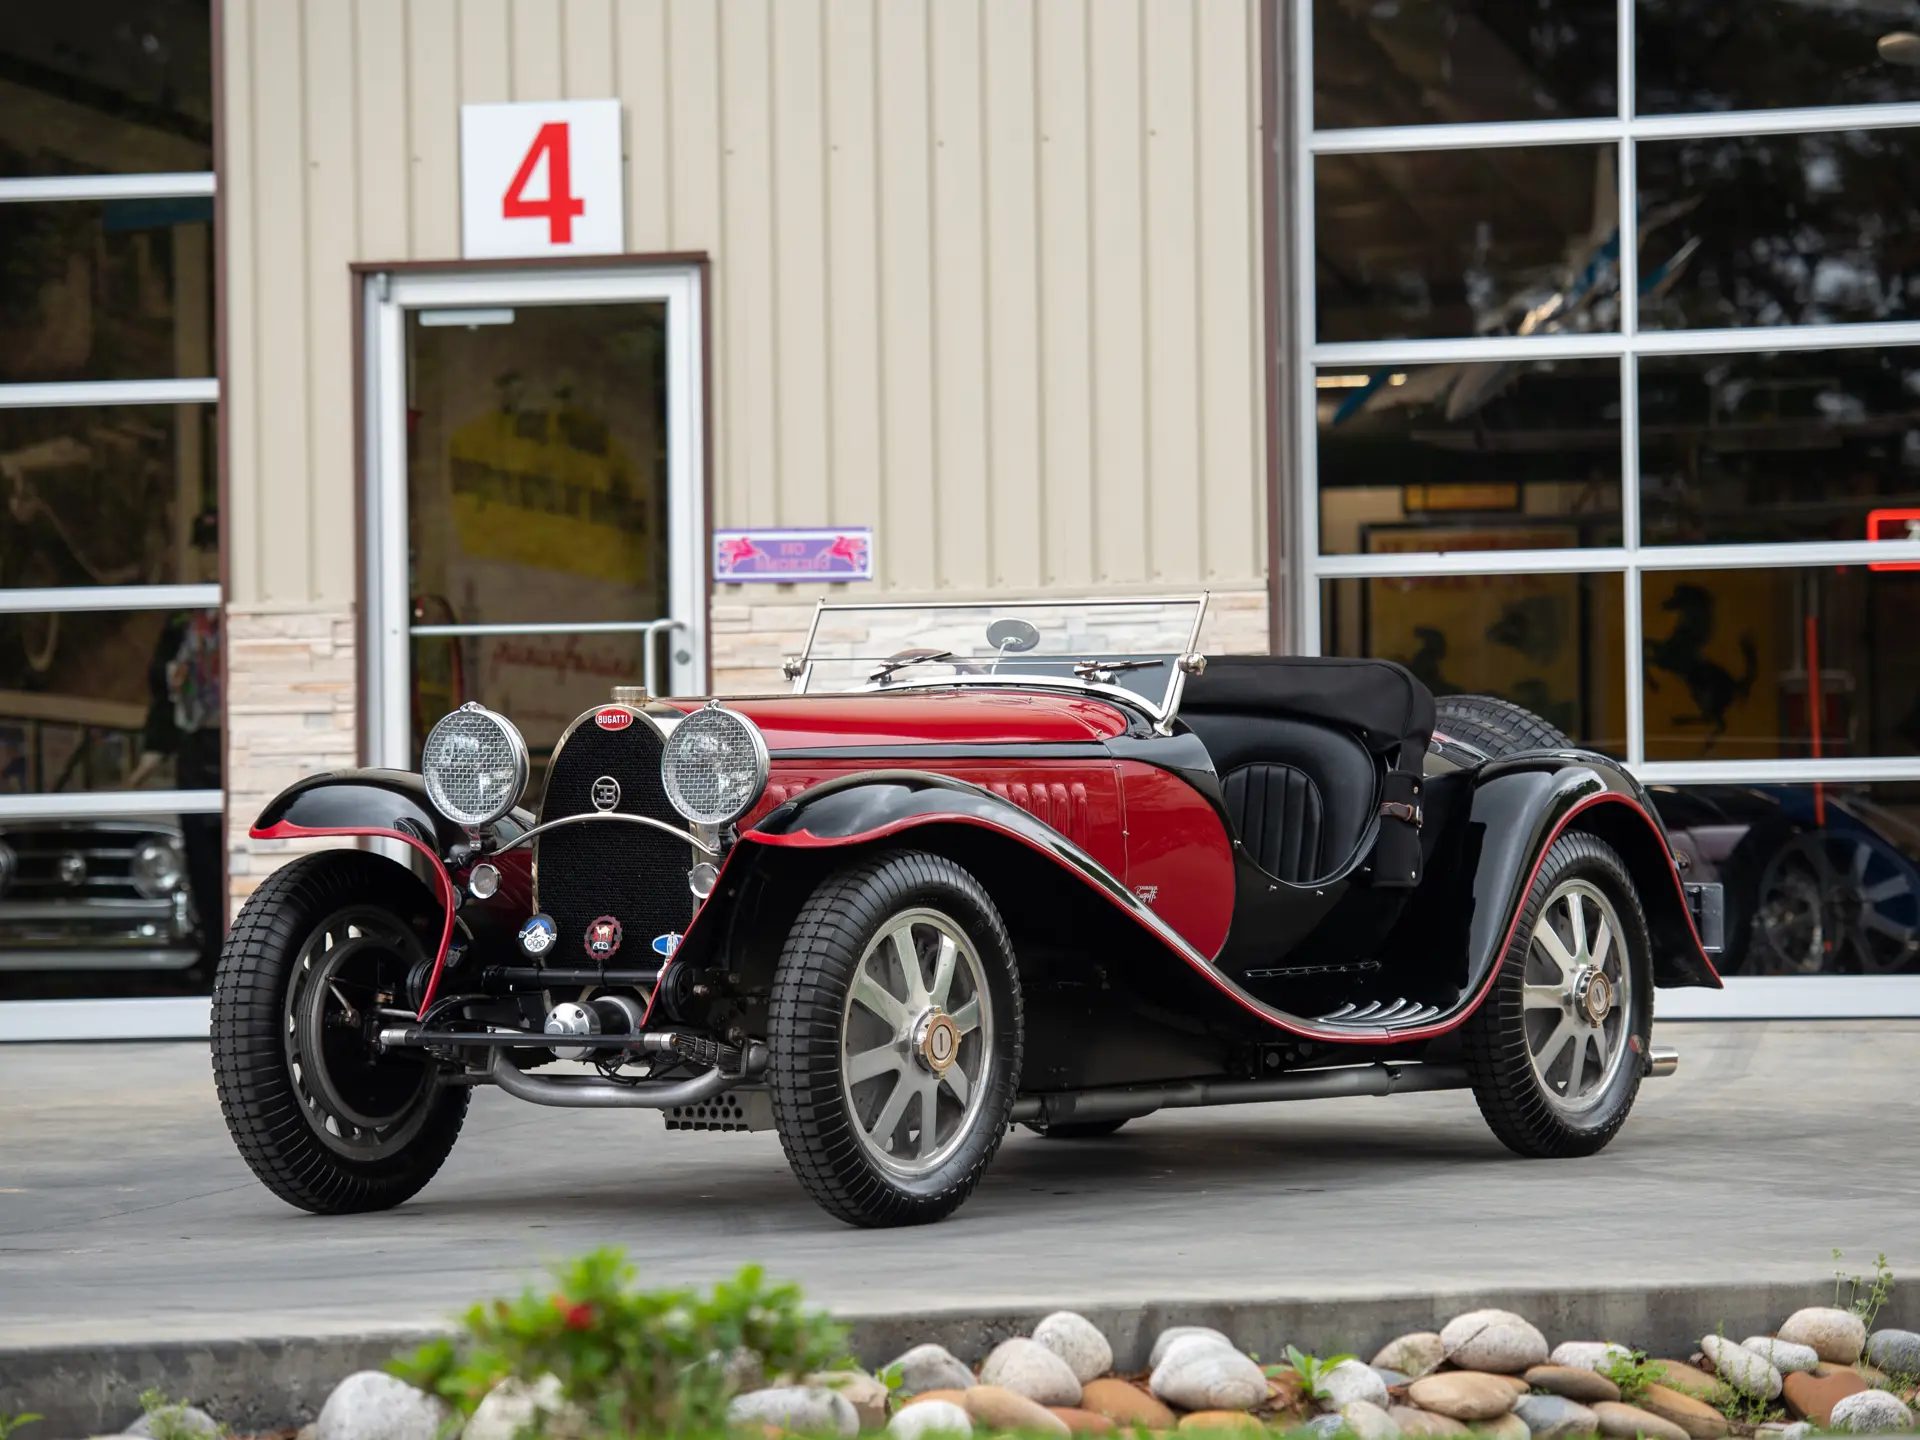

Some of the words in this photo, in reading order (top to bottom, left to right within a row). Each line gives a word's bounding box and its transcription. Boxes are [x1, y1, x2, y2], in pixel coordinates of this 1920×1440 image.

[502, 121, 585, 245] 4
[781, 543, 806, 556] NO
[598, 714, 628, 724] BUGATTI
